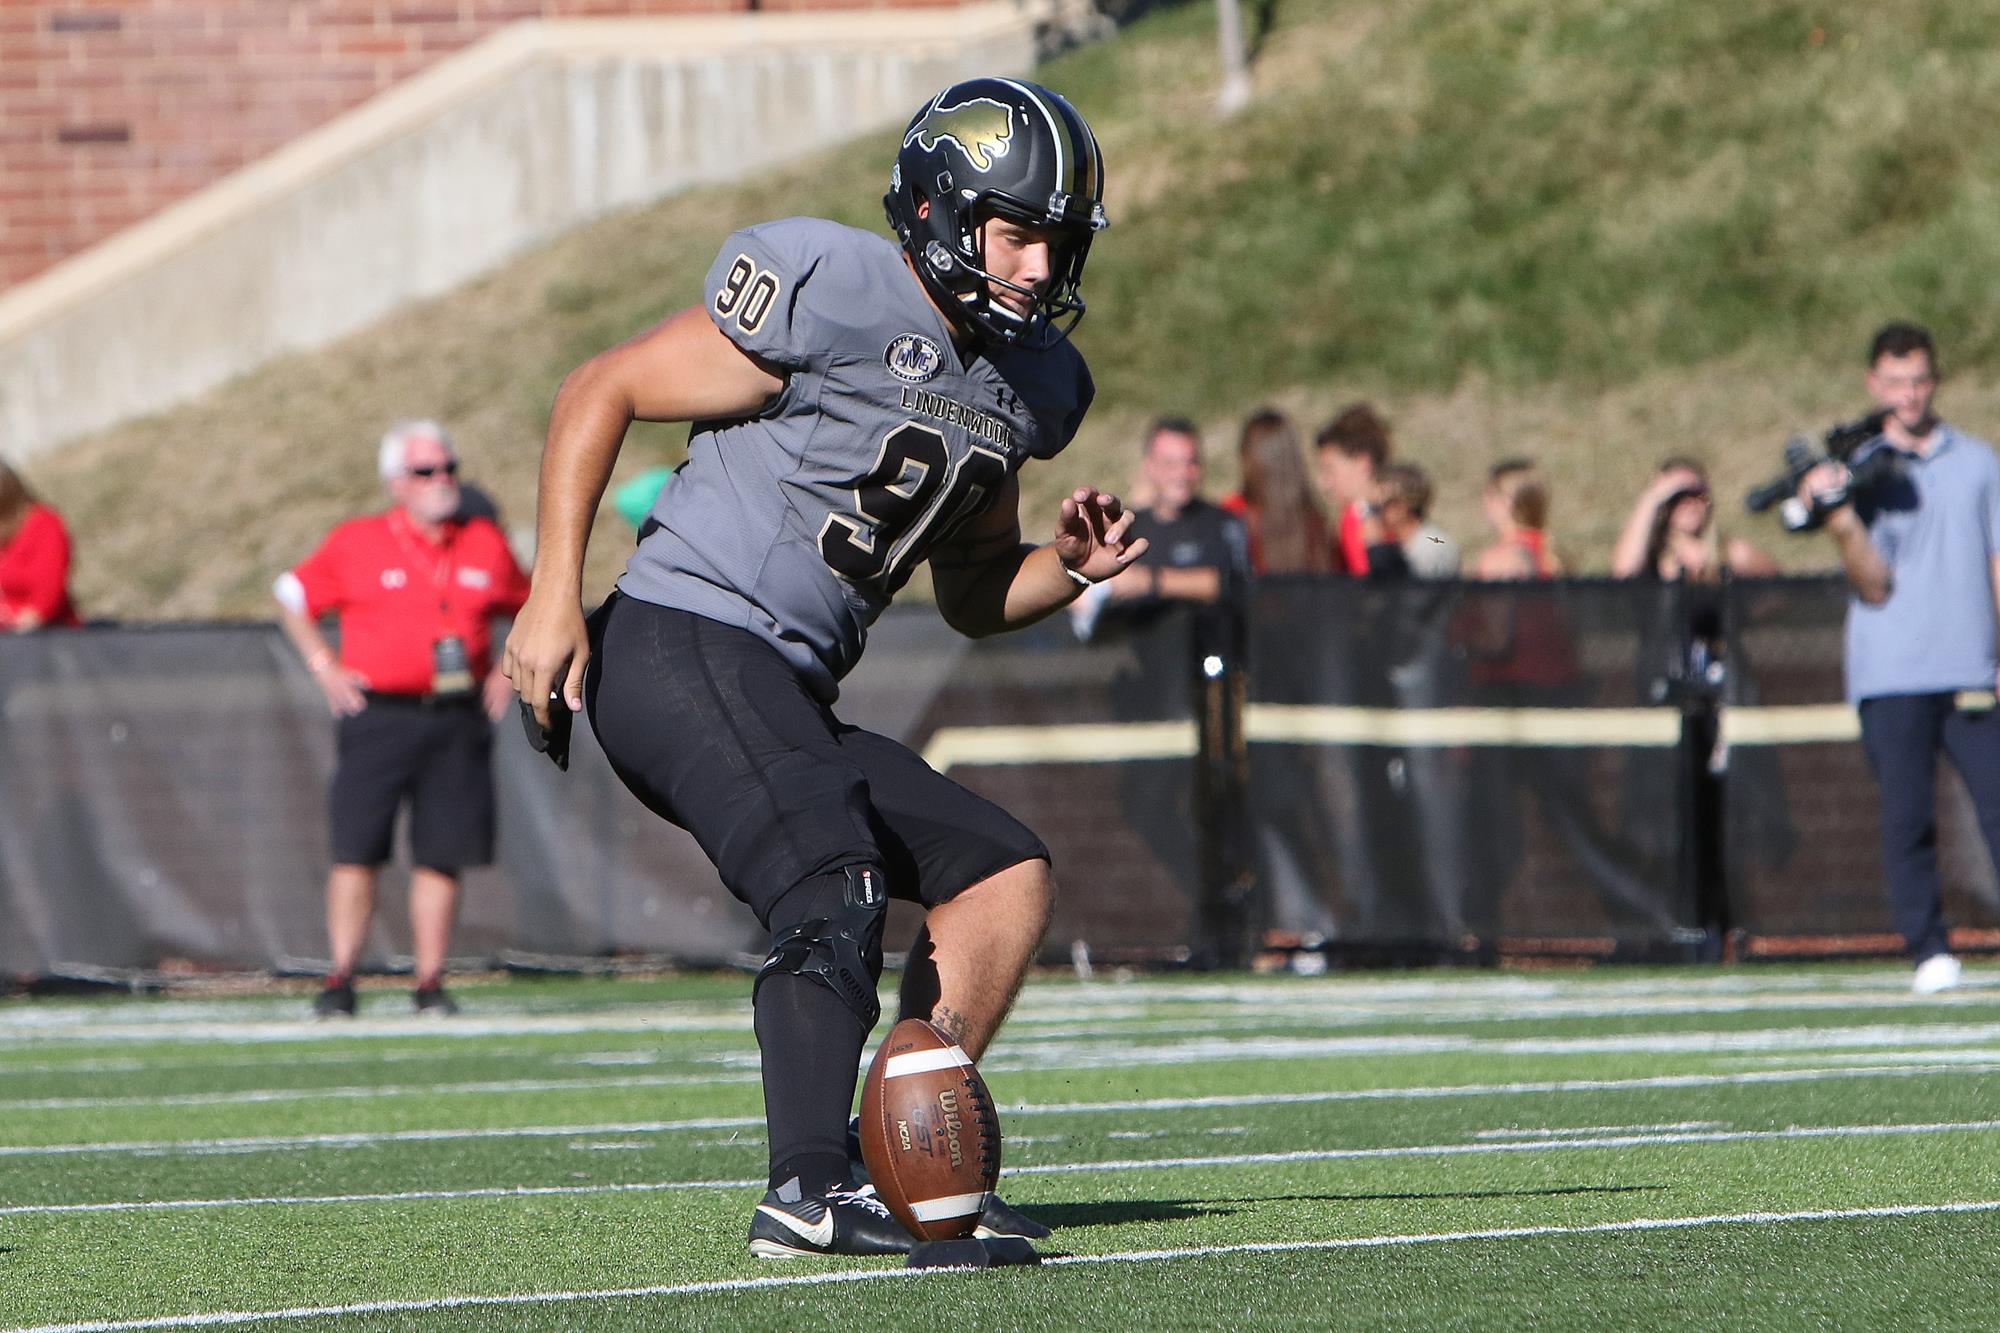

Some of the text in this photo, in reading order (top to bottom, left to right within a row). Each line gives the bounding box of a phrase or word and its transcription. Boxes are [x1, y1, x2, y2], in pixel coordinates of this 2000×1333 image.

[714, 252, 781, 336] 90
[900, 385, 1012, 452] LINDENWOOD
[817, 420, 1008, 590] 90
[864, 877, 873, 904] BREG
[897, 1120, 912, 1152] NCAA
[938, 1088, 963, 1168] Wilson
